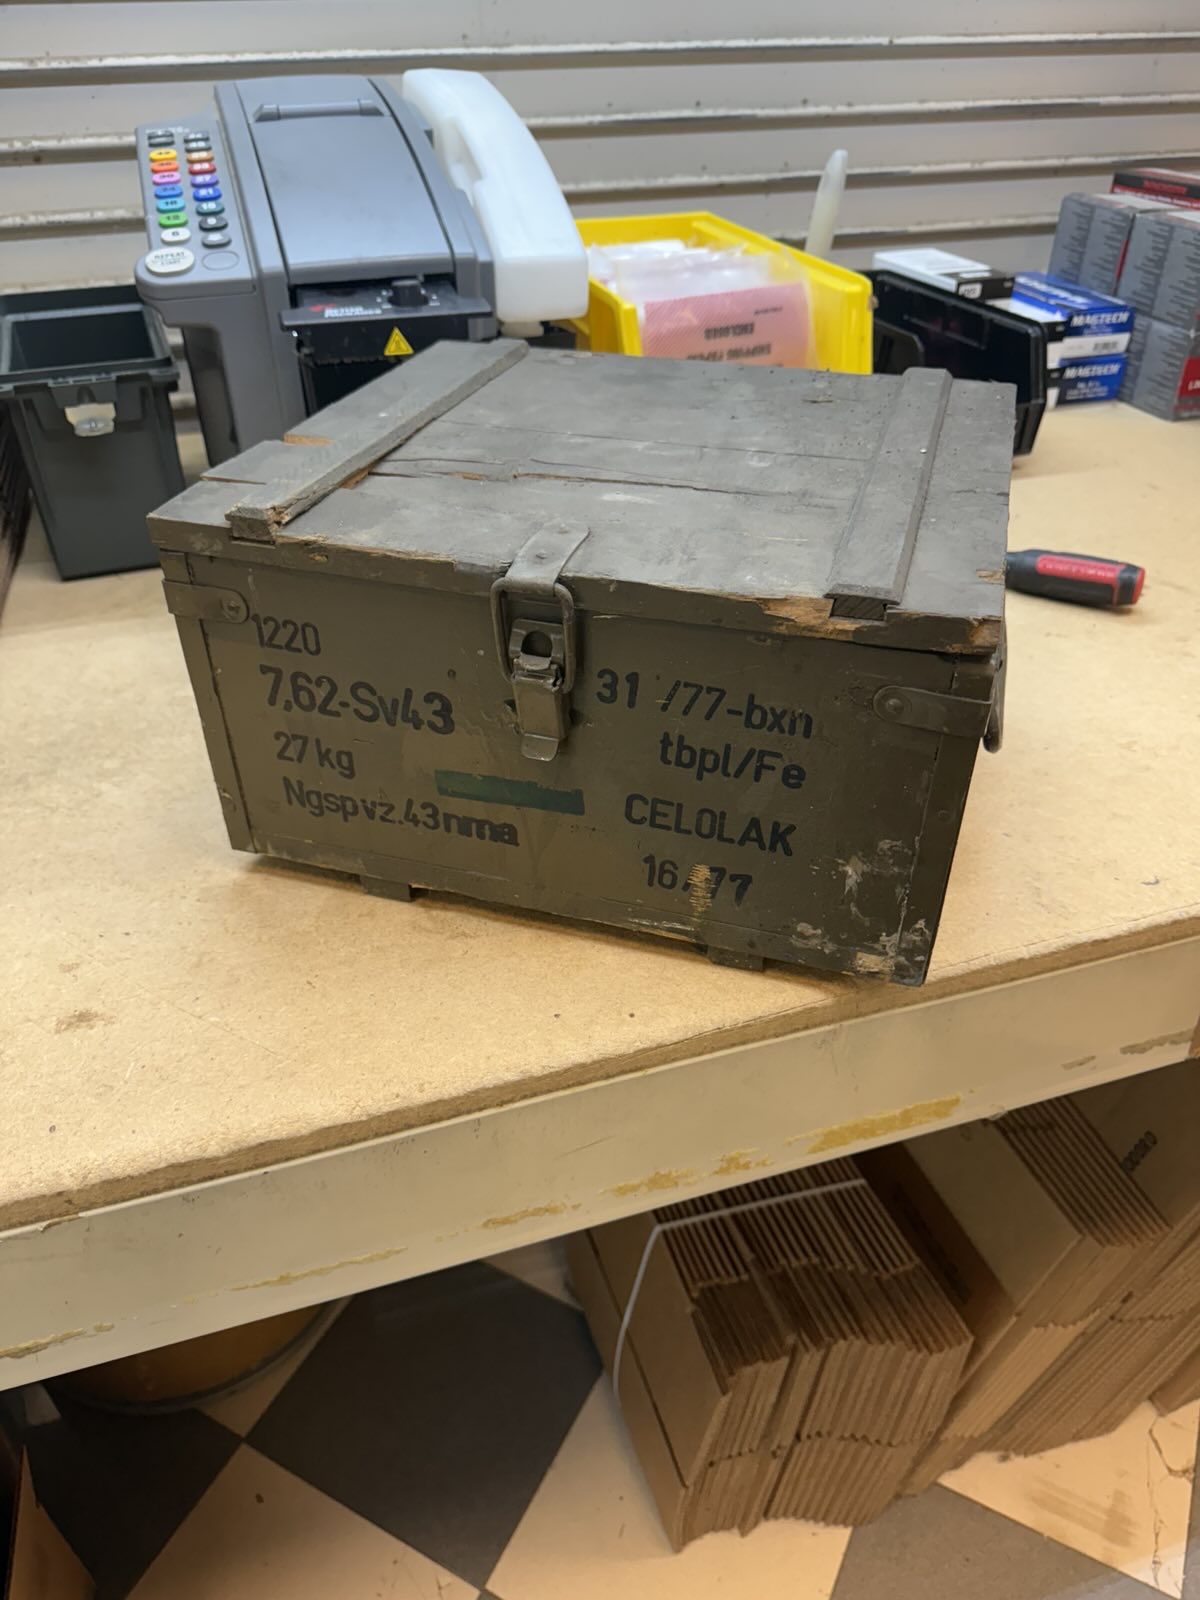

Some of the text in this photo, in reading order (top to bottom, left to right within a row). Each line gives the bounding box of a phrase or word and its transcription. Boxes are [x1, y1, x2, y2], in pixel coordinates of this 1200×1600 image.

[1070, 311, 1130, 327] MAGTECH
[1063, 363, 1121, 380] MAGTECH
[251, 613, 321, 656] 1220
[596, 668, 640, 709] 31
[660, 731, 807, 789] tbpl/Fe
[624, 793, 797, 857] CELOLAK
